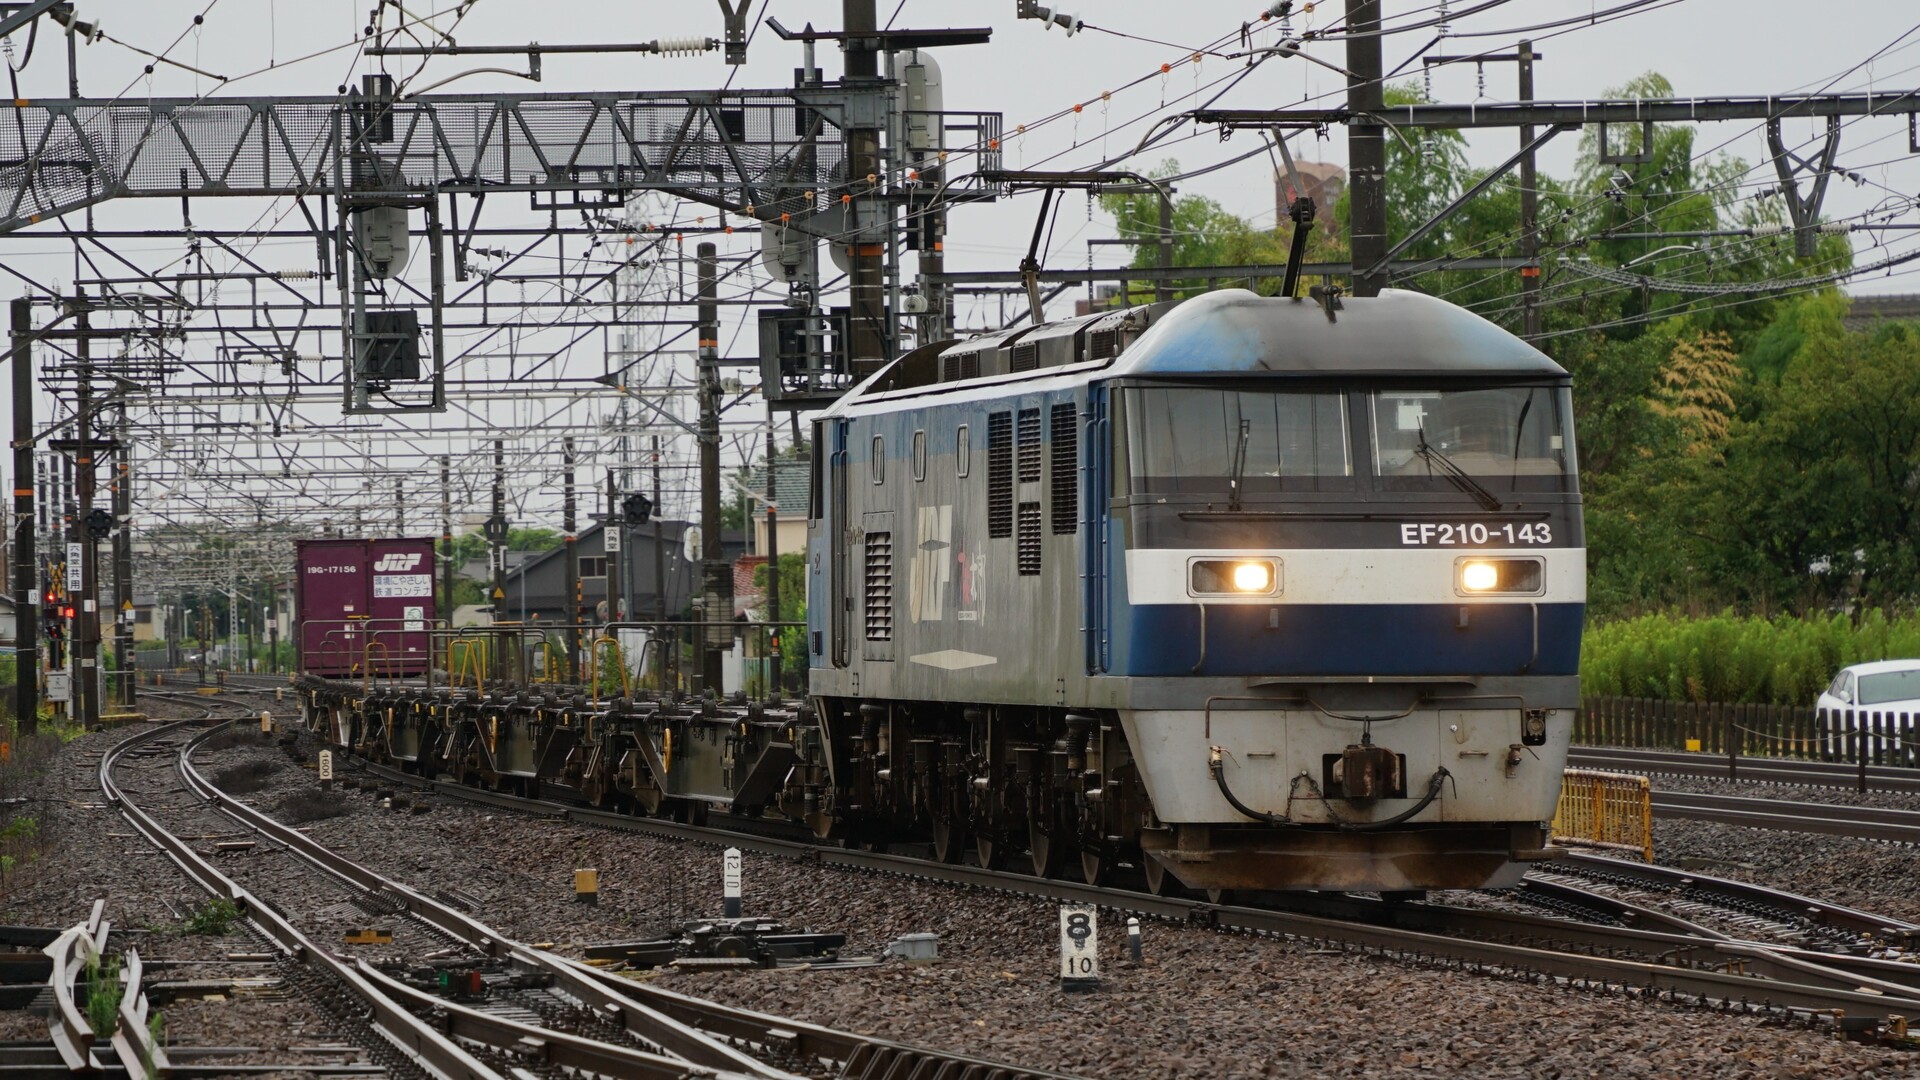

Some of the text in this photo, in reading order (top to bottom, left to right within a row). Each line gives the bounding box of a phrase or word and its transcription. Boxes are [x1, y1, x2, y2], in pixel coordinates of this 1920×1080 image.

[607, 529, 618, 550] 六角堂
[1401, 523, 1552, 545] EF210-143
[307, 566, 357, 574] 19G-17156
[374, 553, 422, 572] JRF
[374, 586, 431, 596] 鉄道コンテナ
[321, 753, 330, 777] 1600
[1067, 913, 1092, 940] 8
[1068, 957, 1092, 974] 10
